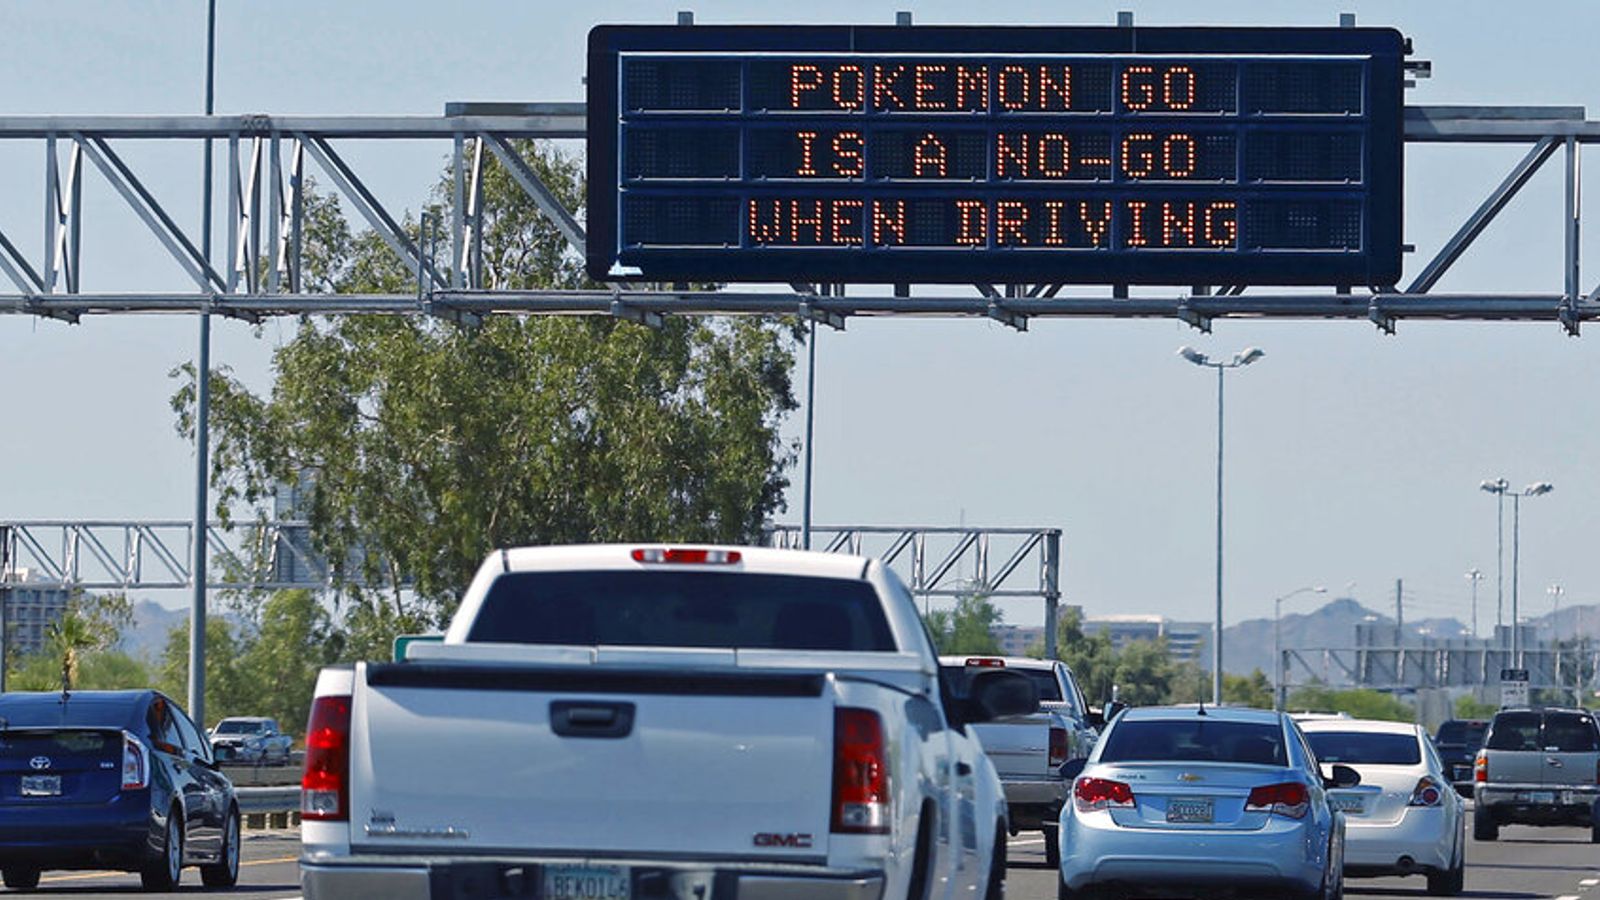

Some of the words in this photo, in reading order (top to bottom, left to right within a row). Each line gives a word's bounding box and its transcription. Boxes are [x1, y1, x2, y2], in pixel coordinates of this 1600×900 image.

[790, 64, 1072, 109] POKEMON
[1121, 66, 1196, 109] GO
[796, 131, 864, 176] IS
[914, 133, 947, 177] A
[996, 133, 1196, 177] NO-GO
[749, 199, 906, 243] WHEN
[954, 200, 1238, 246] DRIVING
[753, 833, 813, 848] GMC
